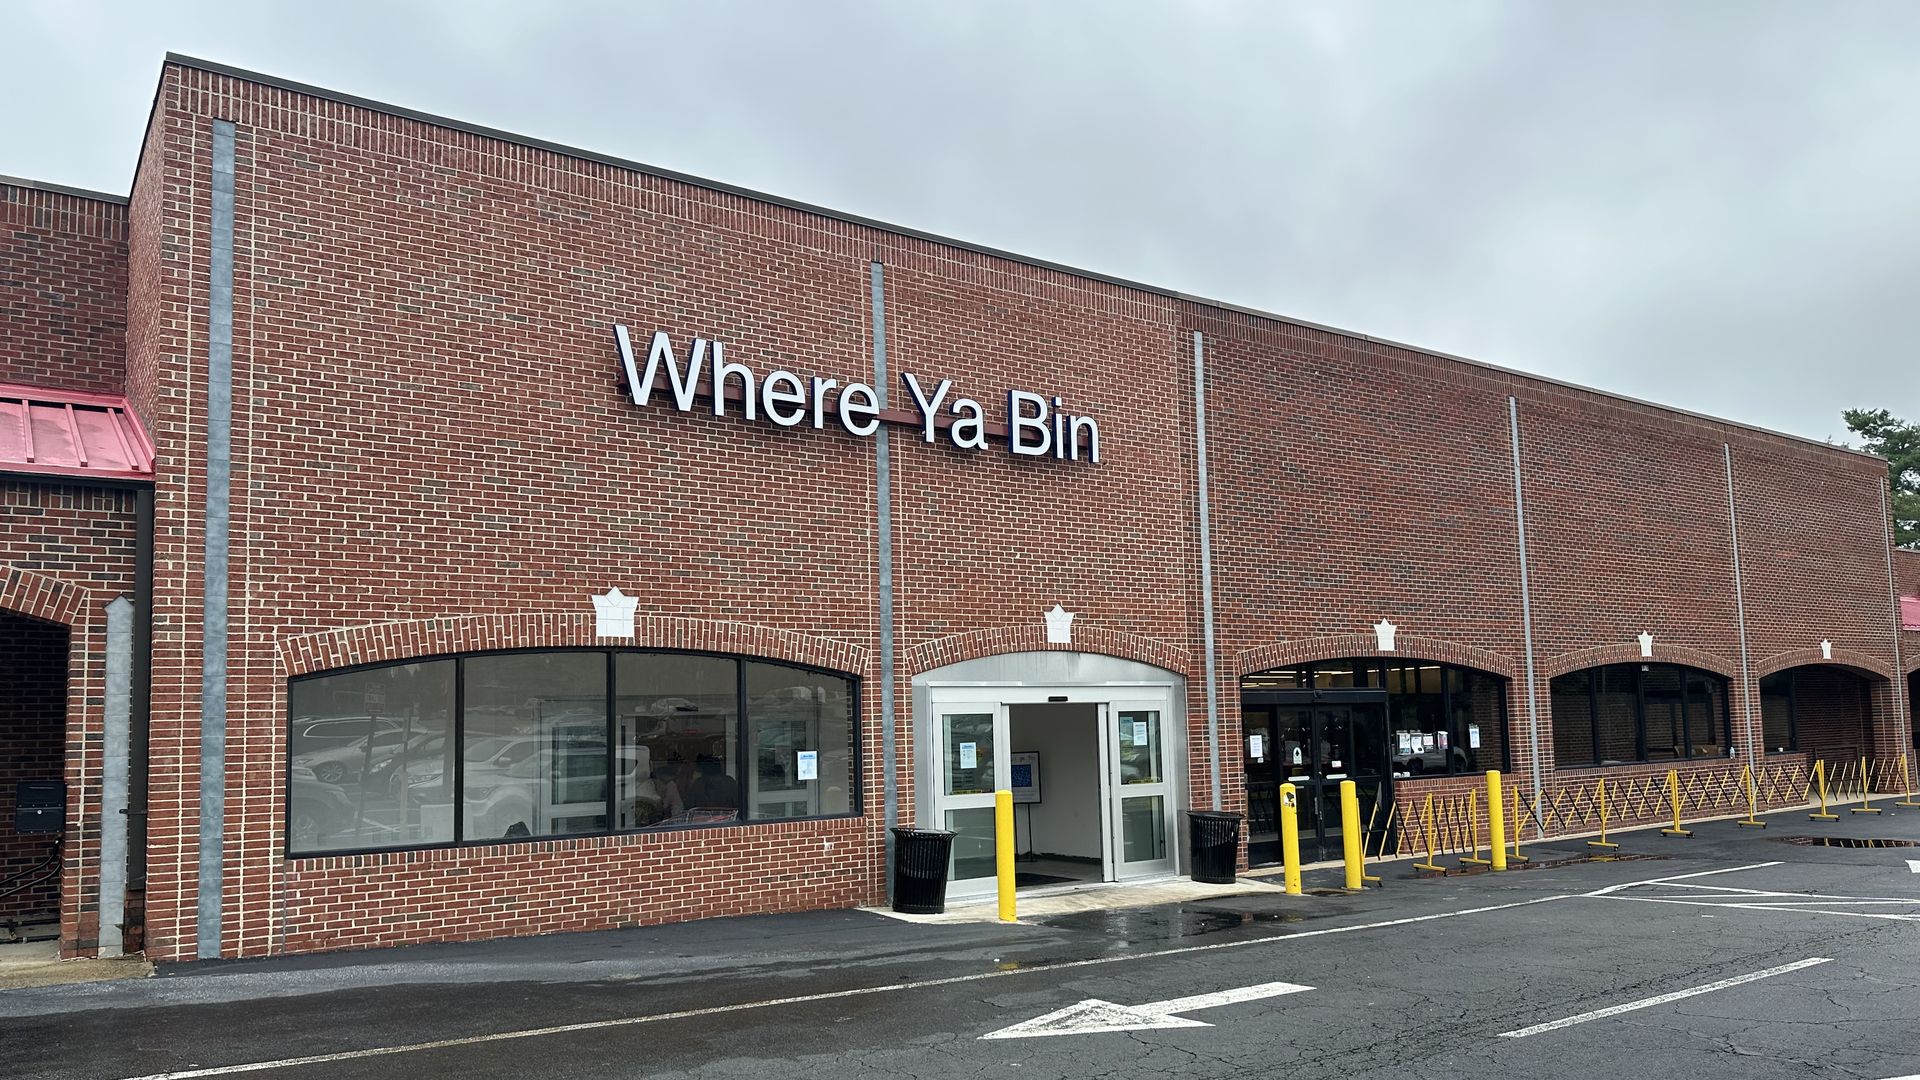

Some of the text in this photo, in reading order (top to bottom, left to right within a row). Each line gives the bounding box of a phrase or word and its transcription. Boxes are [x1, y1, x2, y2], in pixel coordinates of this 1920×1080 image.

[614, 324, 1101, 463] Where Ya Bin
